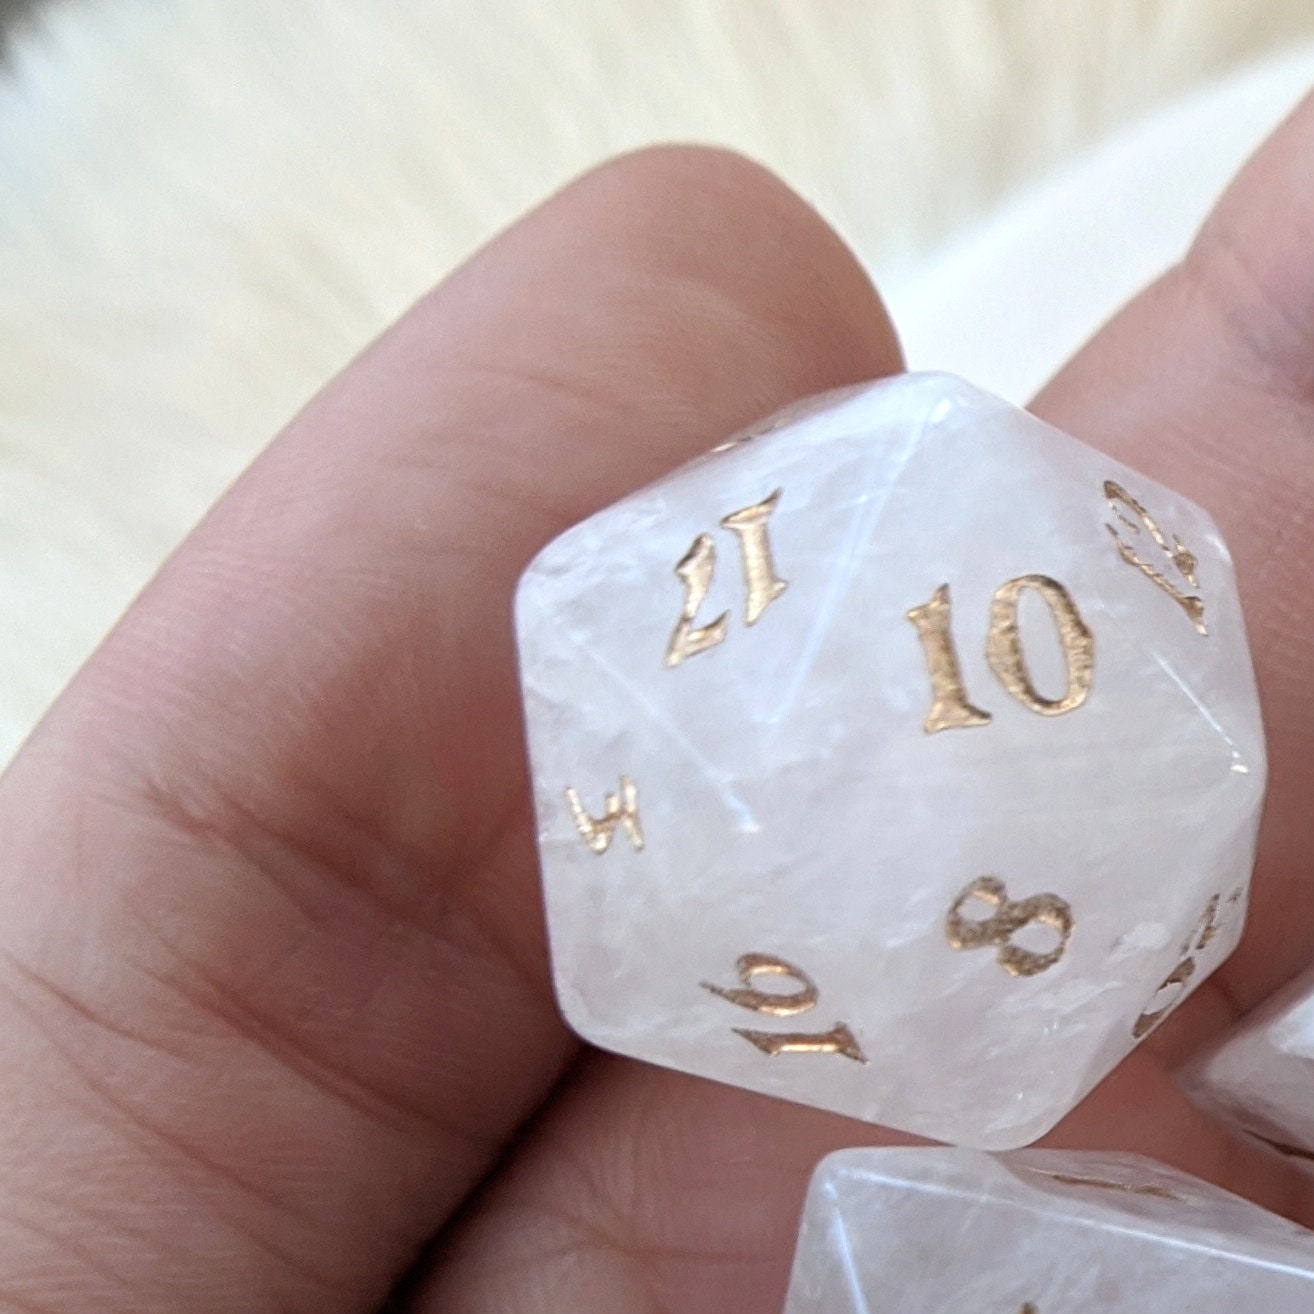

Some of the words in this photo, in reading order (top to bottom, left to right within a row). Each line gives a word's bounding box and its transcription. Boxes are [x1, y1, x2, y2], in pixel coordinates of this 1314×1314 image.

[663, 487, 788, 668] 17
[906, 573, 1093, 734] 10
[945, 876, 1074, 977] 8
